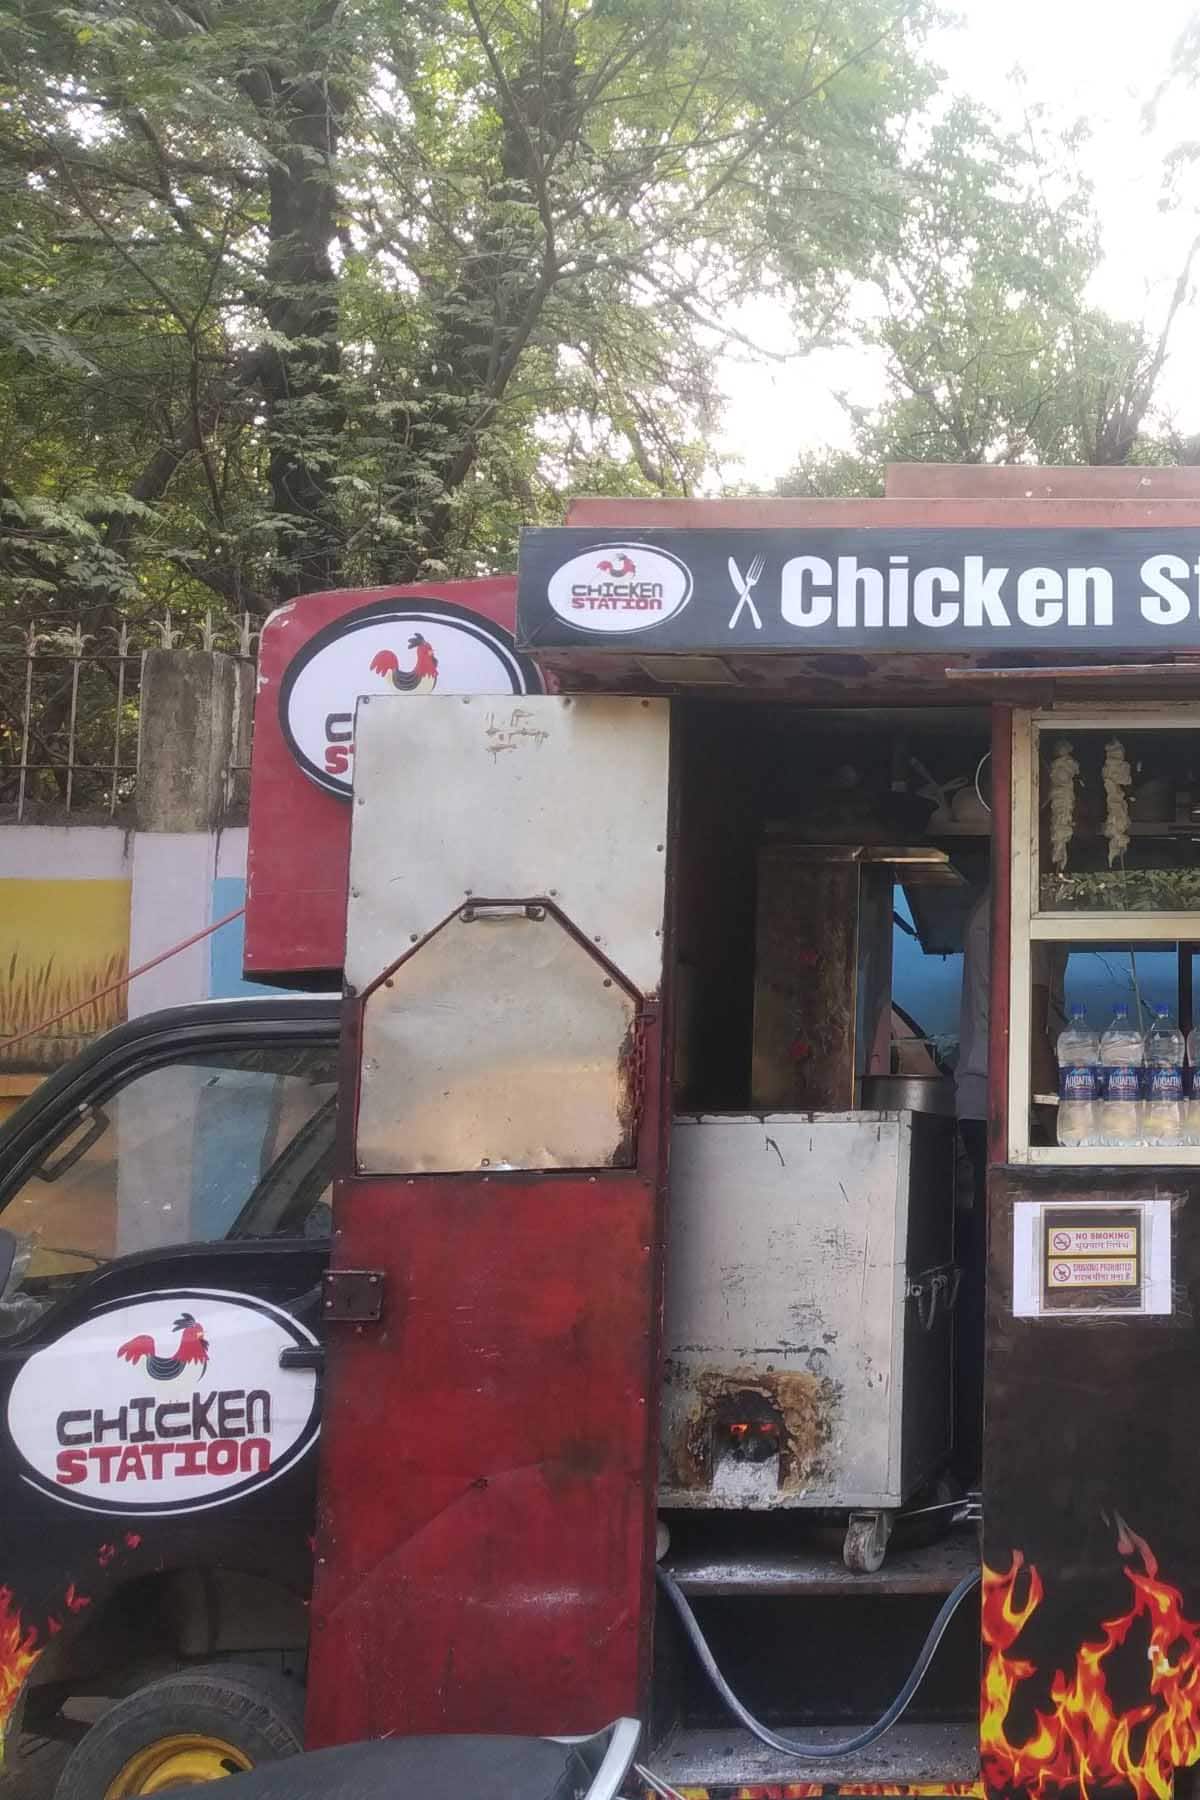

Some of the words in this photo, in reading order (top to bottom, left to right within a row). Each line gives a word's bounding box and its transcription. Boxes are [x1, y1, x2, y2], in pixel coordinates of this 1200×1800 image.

[571, 582, 664, 598] CHICKEN
[571, 597, 663, 610] STATION
[780, 555, 1112, 627] Chicken
[1075, 1232, 1088, 1240] NO
[1090, 1232, 1130, 1240] SMOKING
[56, 1389, 271, 1447] CHICKEN
[56, 1438, 272, 1485] STATION
